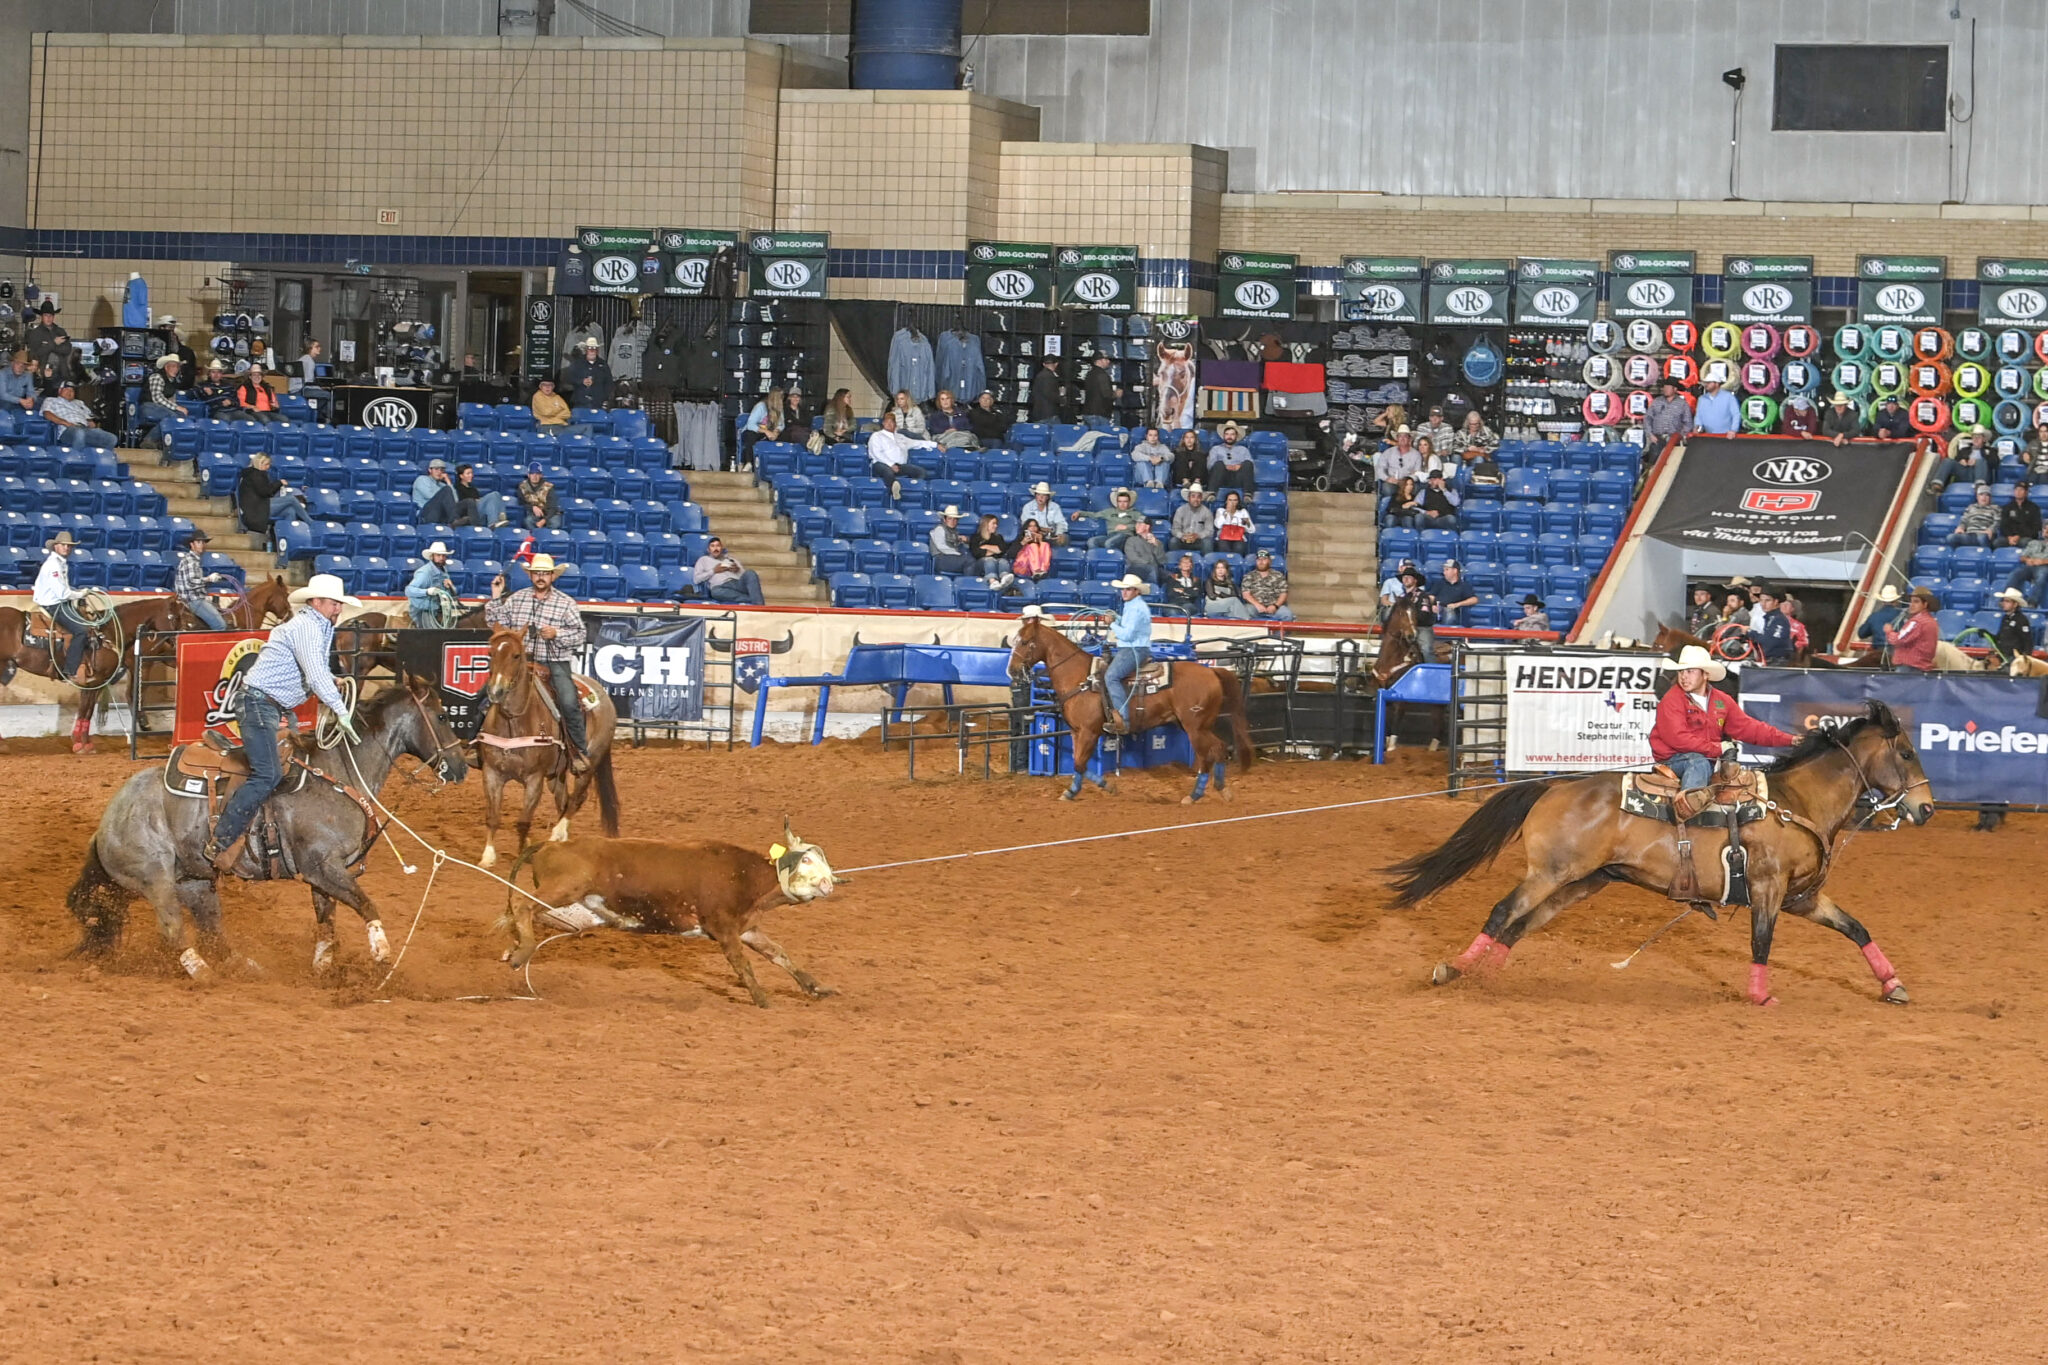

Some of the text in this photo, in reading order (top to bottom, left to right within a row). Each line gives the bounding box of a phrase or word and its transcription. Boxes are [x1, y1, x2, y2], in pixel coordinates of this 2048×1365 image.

[381, 211, 396, 222] EXIT
[583, 231, 600, 245] NRS
[665, 233, 683, 248] NRS
[754, 236, 773, 250] NRS
[975, 245, 1048, 260] NRS 800-GO-ROPIN
[1061, 250, 1134, 264] NRS 800-GO-ROPIN
[600, 260, 629, 280] NRS
[1226, 255, 1244, 270] NRS
[1350, 260, 1368, 275] NRS
[1437, 263, 1454, 277] NRS
[1617, 255, 1690, 270] NRS 800-GO-ROPIN
[1732, 260, 1808, 275] NRS 800-GO-ROPIN
[1865, 259, 1940, 275] NRS 800-GO-ROPIN
[683, 259, 706, 282] NR
[773, 263, 802, 285] NRS
[1523, 263, 1542, 278] NRS
[1985, 263, 2005, 278] NRS
[590, 285, 639, 293] RSworld.co
[664, 287, 702, 295] NRSwor
[995, 273, 1026, 295] NRS
[1082, 276, 1111, 298] NRS
[753, 289, 820, 297] NRSworld.com
[1242, 284, 1271, 305] NRS
[1376, 289, 1397, 309] RS
[1454, 290, 1484, 311] NRS
[1636, 283, 1667, 304] NRS
[1751, 288, 1783, 309] NRS
[1885, 288, 1916, 310] NRS
[975, 299, 1045, 308] NRSworld.com
[1541, 292, 1571, 312] NRS
[2006, 292, 2038, 314] NRS
[533, 303, 549, 320] NRS
[1223, 308, 1290, 318] NRSworld.com
[1615, 308, 1686, 317] NRSworld.com
[1730, 314, 1804, 323] NRSworld.com
[1863, 314, 1936, 323] NRSworld.com
[1434, 315, 1503, 324] NRSworld.com
[1520, 315, 1589, 325] NRSworld.com
[1165, 319, 1187, 337] NRS
[373, 402, 407, 428] NRS
[1763, 459, 1821, 483] NRS
[1755, 492, 1807, 509] HP
[1711, 511, 1771, 520] HORSE
[1712, 532, 1769, 545] Things
[1772, 536, 1843, 544] Western
[1714, 527, 1751, 535] YOUR
[735, 641, 768, 652] USTRC
[1633, 698, 1657, 712] Equ
[1525, 753, 1655, 764] www.hendershotequip
